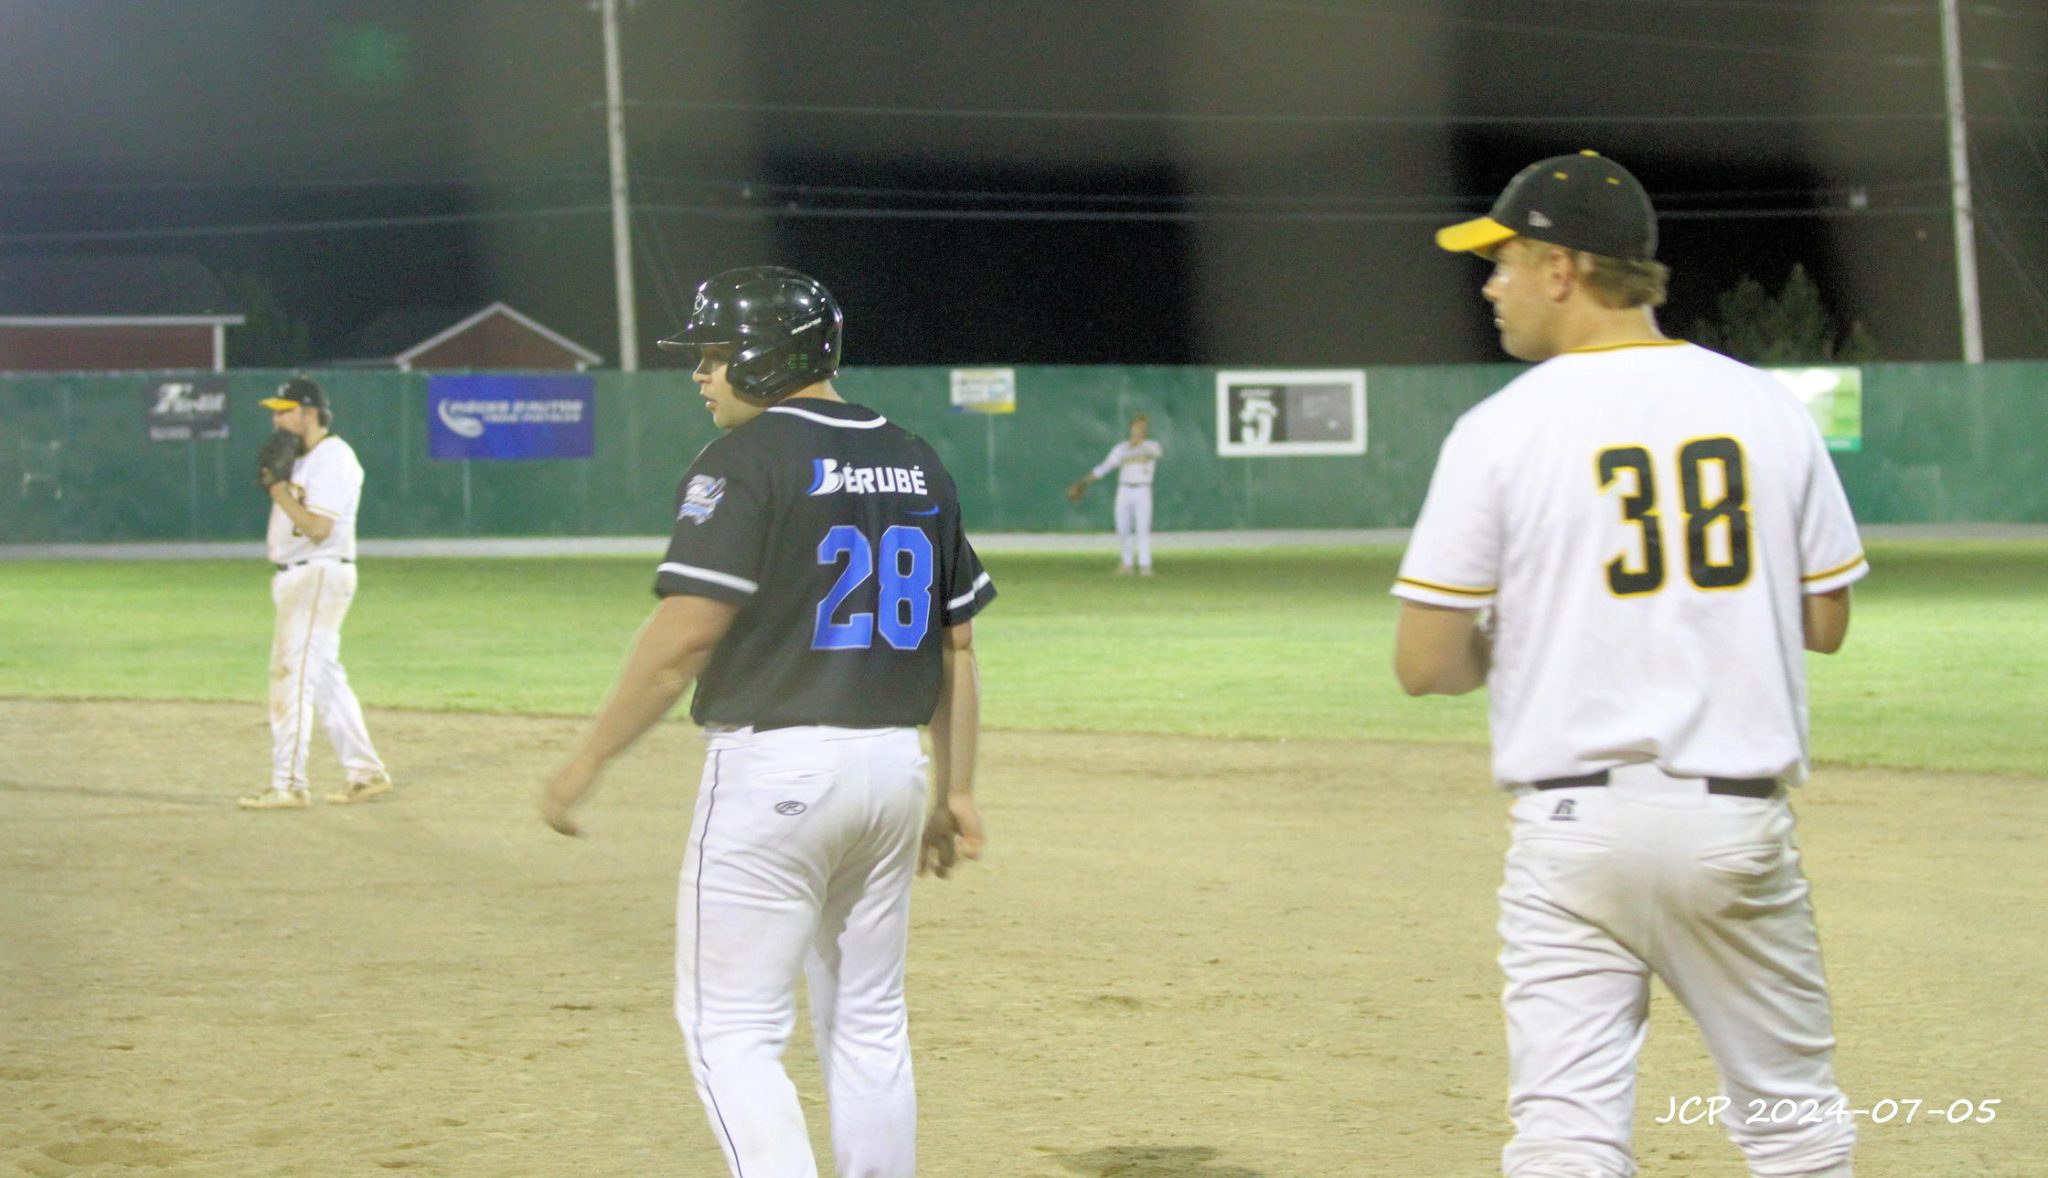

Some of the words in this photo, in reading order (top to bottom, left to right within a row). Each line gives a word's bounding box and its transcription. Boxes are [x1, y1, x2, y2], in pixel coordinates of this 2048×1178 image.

[806, 458, 928, 496] BÉRUBÉ
[1594, 433, 1754, 598] 38
[811, 524, 933, 650] 28
